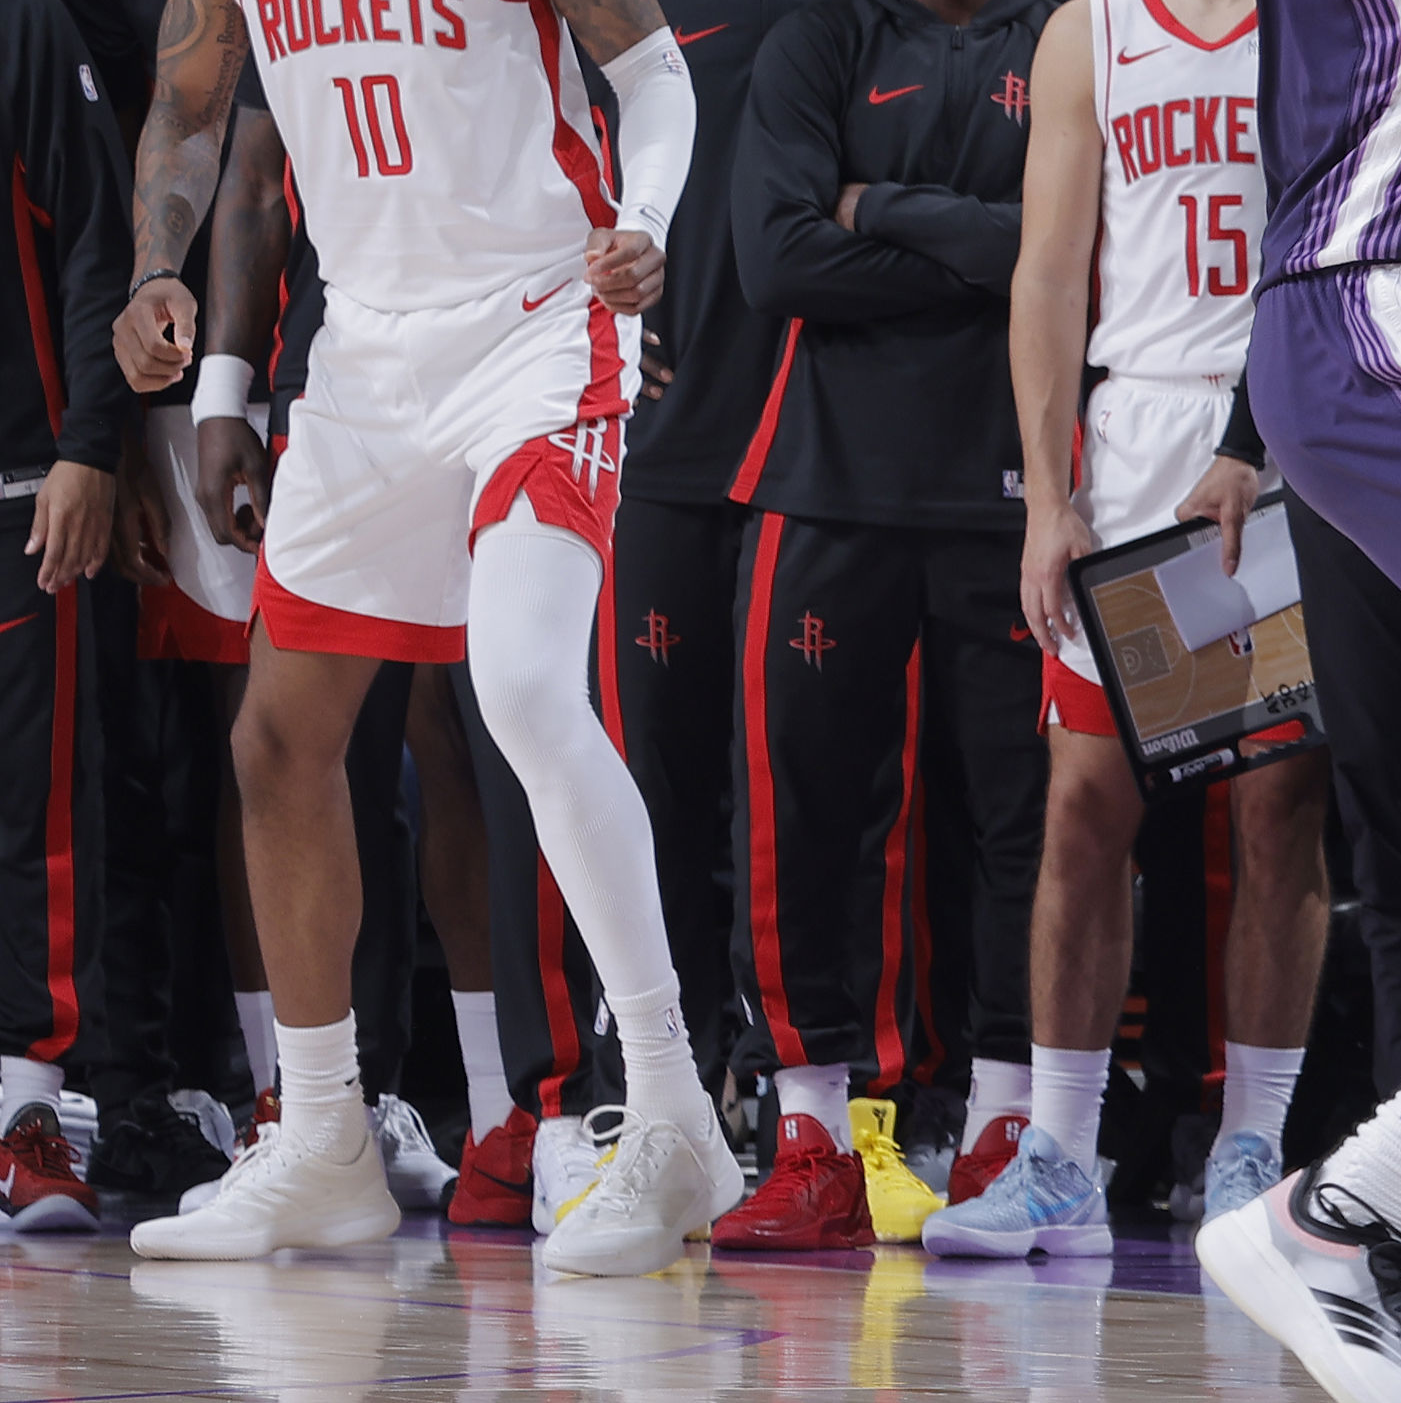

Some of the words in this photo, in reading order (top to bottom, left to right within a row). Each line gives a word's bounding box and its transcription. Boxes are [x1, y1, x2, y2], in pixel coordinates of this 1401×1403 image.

[331, 74, 413, 178] 10
[1111, 95, 1256, 185] ROCKE
[1178, 194, 1249, 297] 15
[1142, 727, 1200, 757] Wilson
